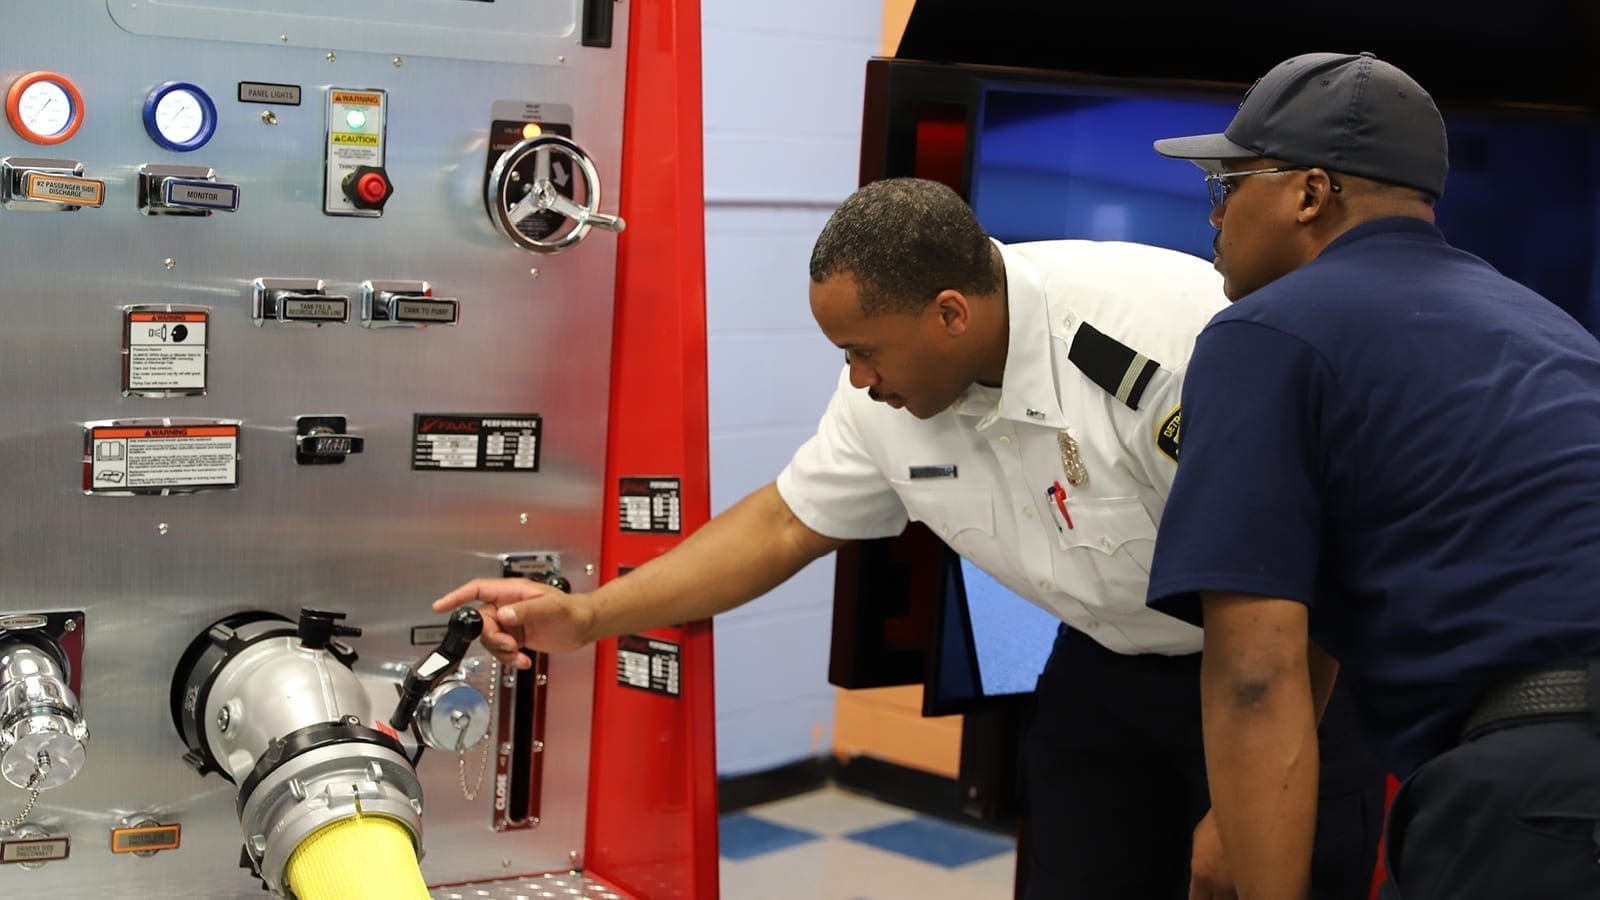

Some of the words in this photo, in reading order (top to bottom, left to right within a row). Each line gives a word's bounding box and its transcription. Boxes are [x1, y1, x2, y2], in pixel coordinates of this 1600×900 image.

[248, 89, 269, 98] PANEL
[270, 90, 294, 99] LIGHTS
[341, 95, 378, 104] WARNING
[340, 135, 377, 144] CAUTION
[45, 181, 81, 192] PASSENGER
[81, 185, 96, 193] SIDE
[48, 188, 82, 198] DISCHARGE
[186, 190, 218, 201] MONITOR
[482, 419, 537, 428] PERFORMANCE
[151, 428, 188, 436] WARNING
[496, 774, 507, 810] CLOSE
